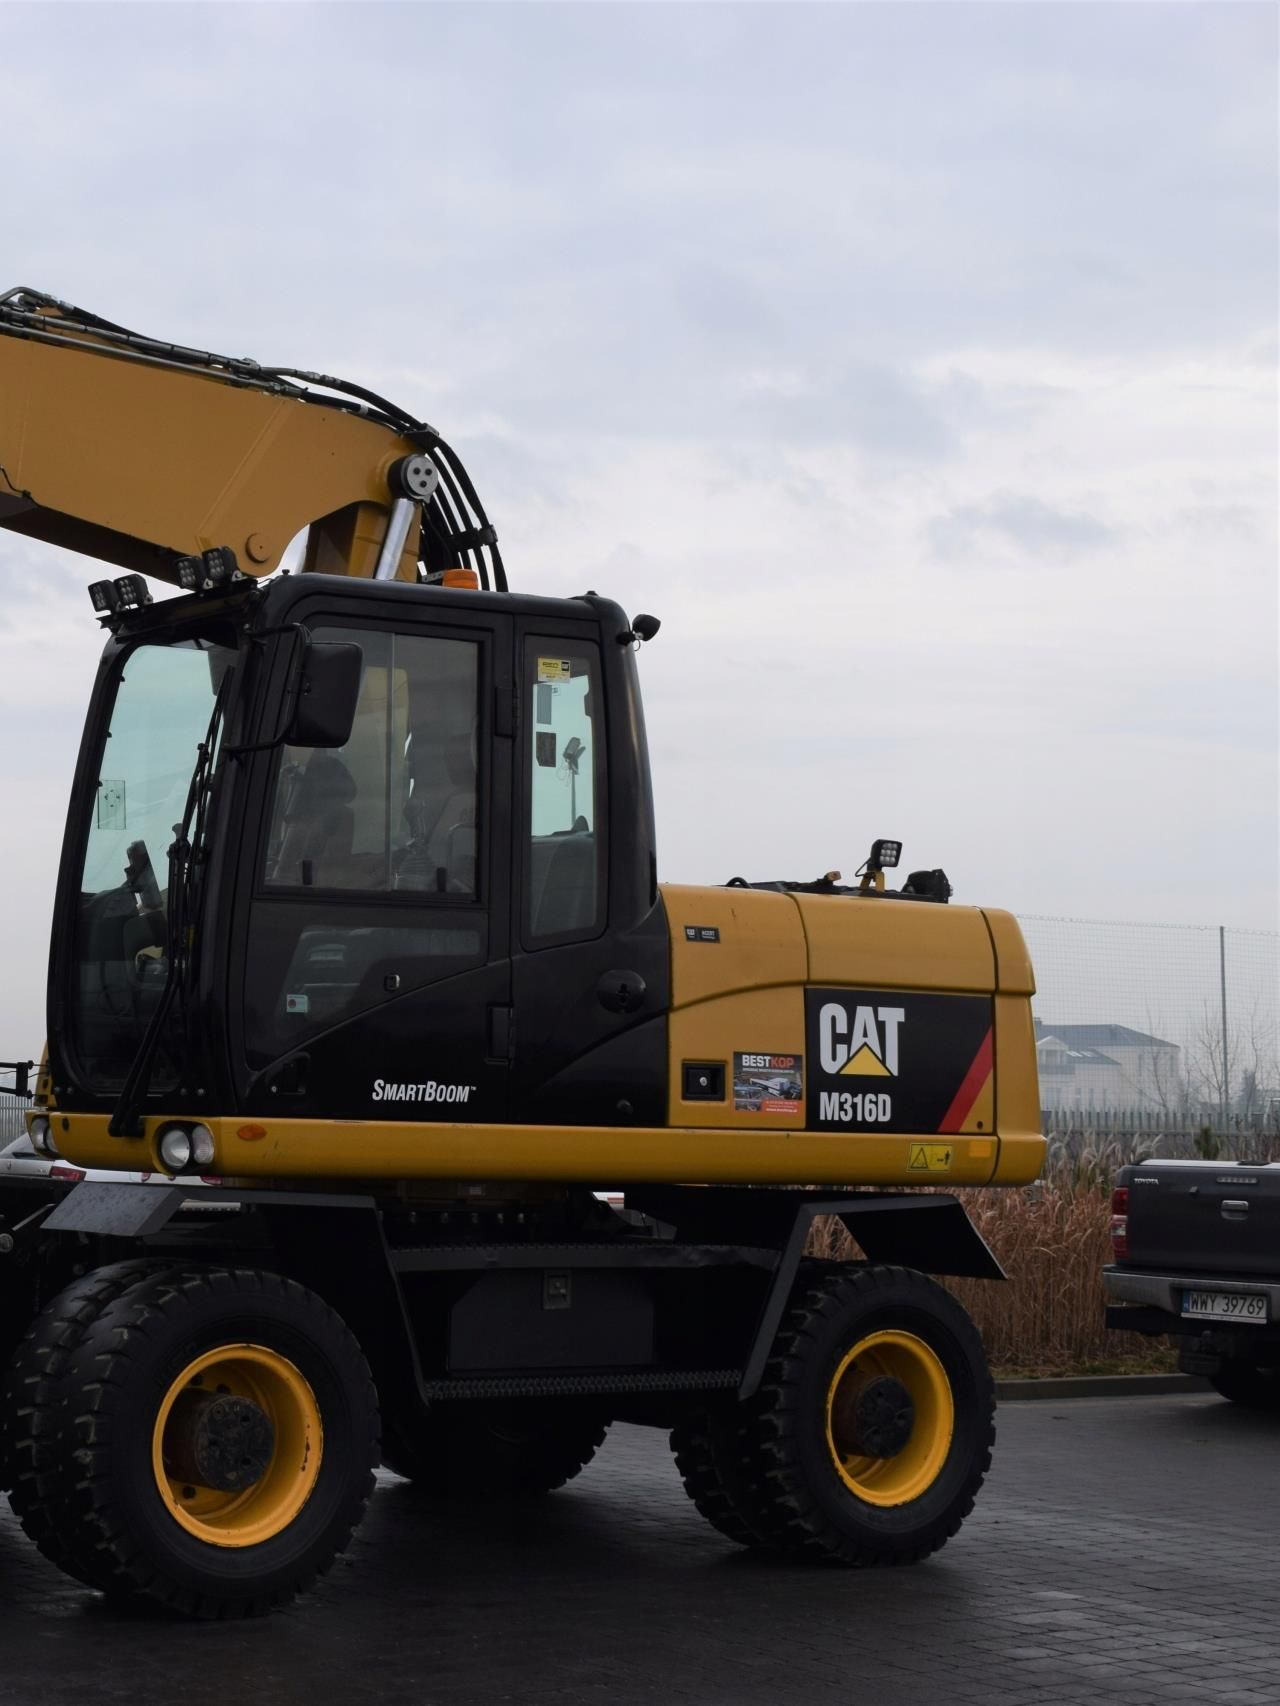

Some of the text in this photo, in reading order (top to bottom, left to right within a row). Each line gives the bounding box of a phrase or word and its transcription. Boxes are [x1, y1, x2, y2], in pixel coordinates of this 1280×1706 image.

[819, 1002, 906, 1077] CAT
[742, 1055, 795, 1069] BESTKOP
[819, 1091, 892, 1122] M316D
[1191, 1293, 1265, 1315] WWY 39769
